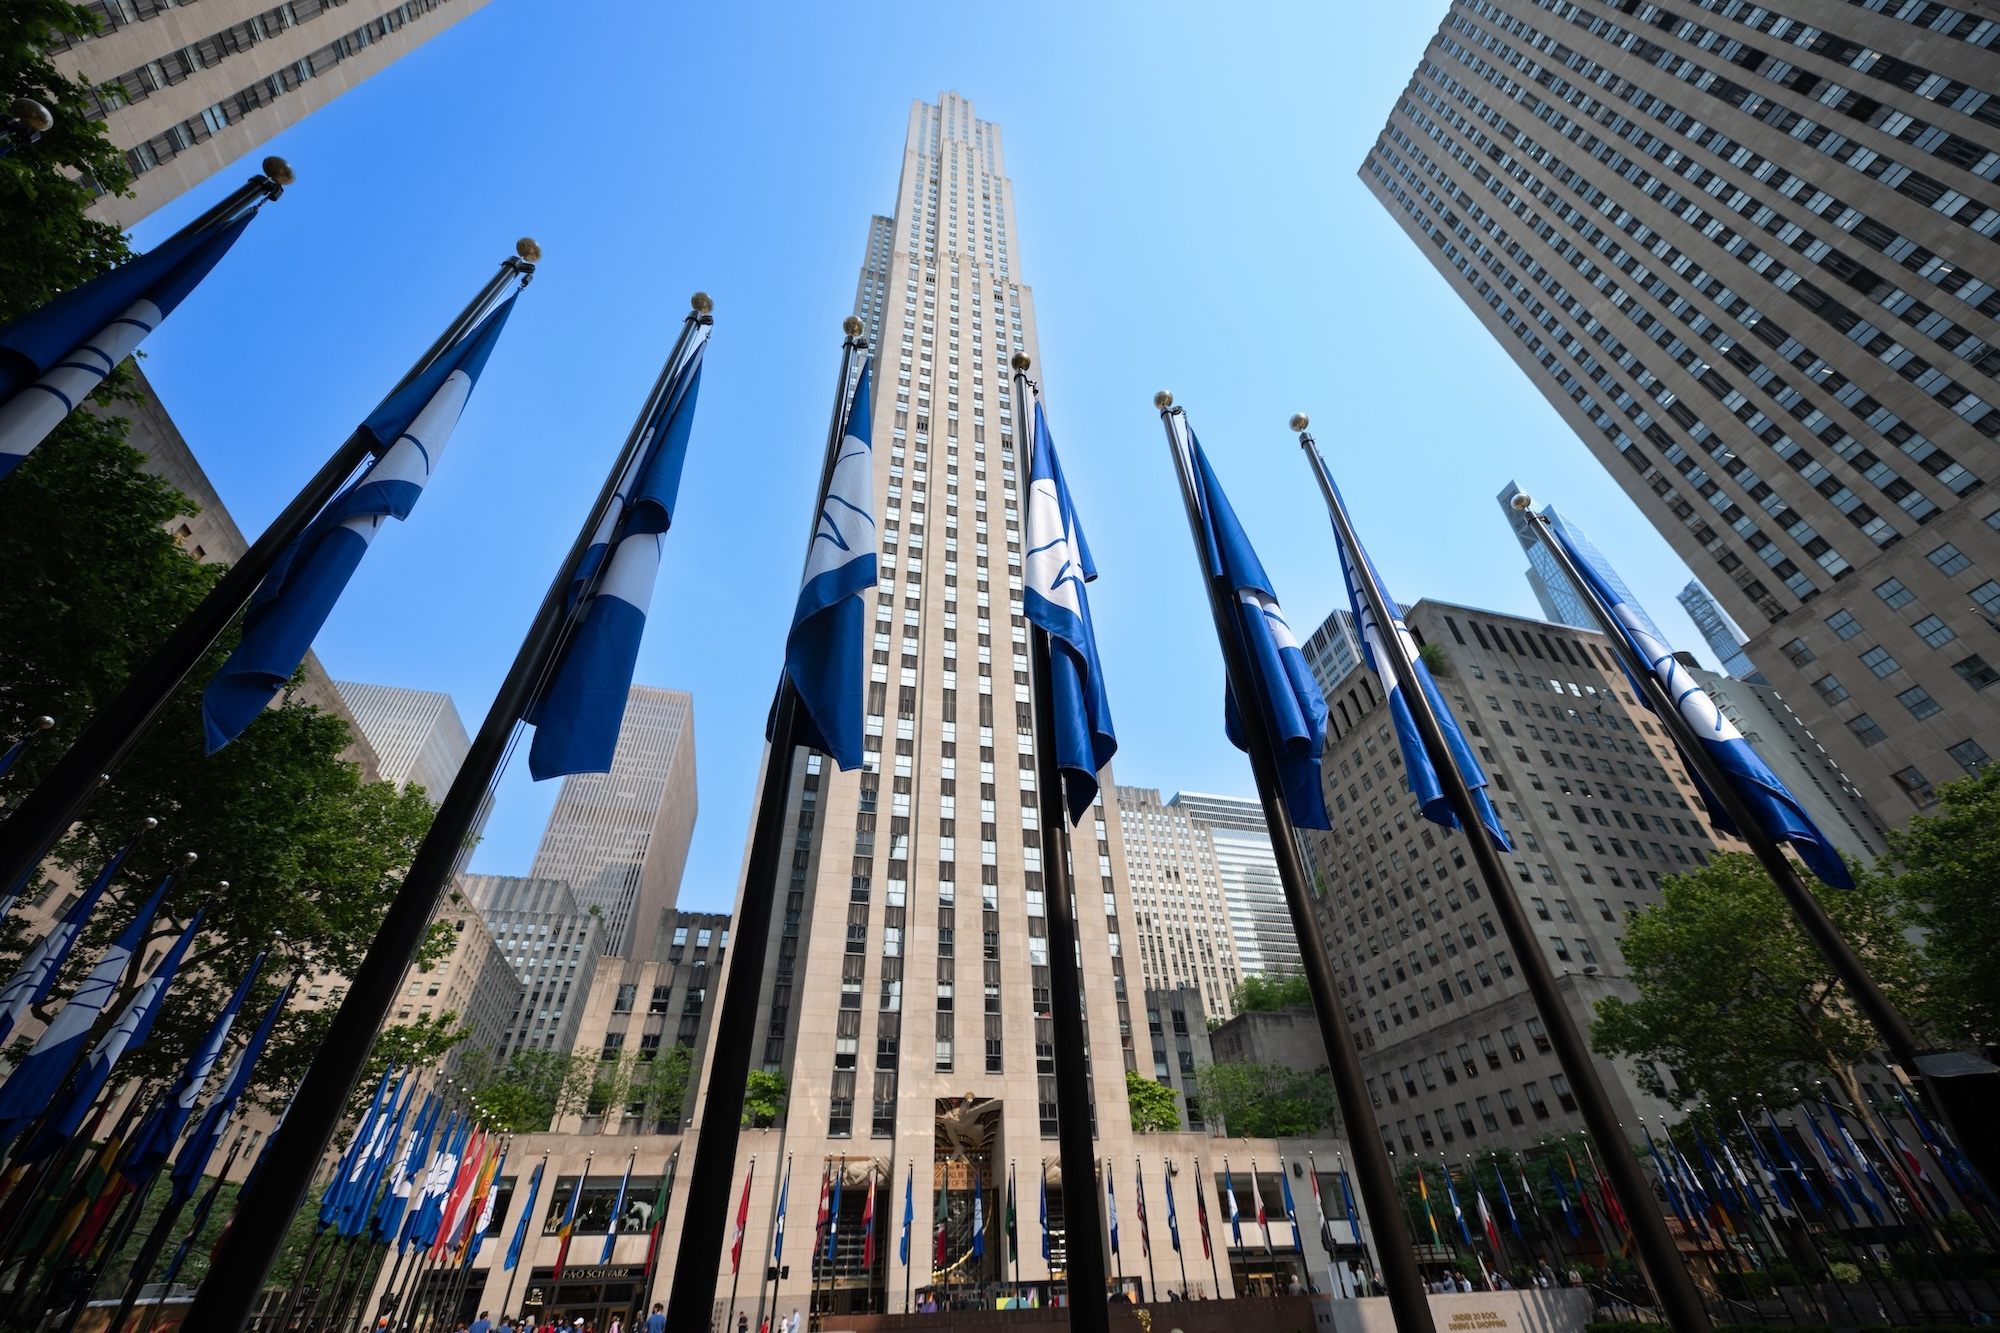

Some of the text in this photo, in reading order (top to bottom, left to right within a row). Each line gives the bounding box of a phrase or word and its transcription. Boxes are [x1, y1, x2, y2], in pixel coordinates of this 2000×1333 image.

[1452, 1312, 1498, 1322] UNDER 30 ROCK
[1448, 1322, 1470, 1331] DINING
[1476, 1320, 1507, 1329] SHOPPING
